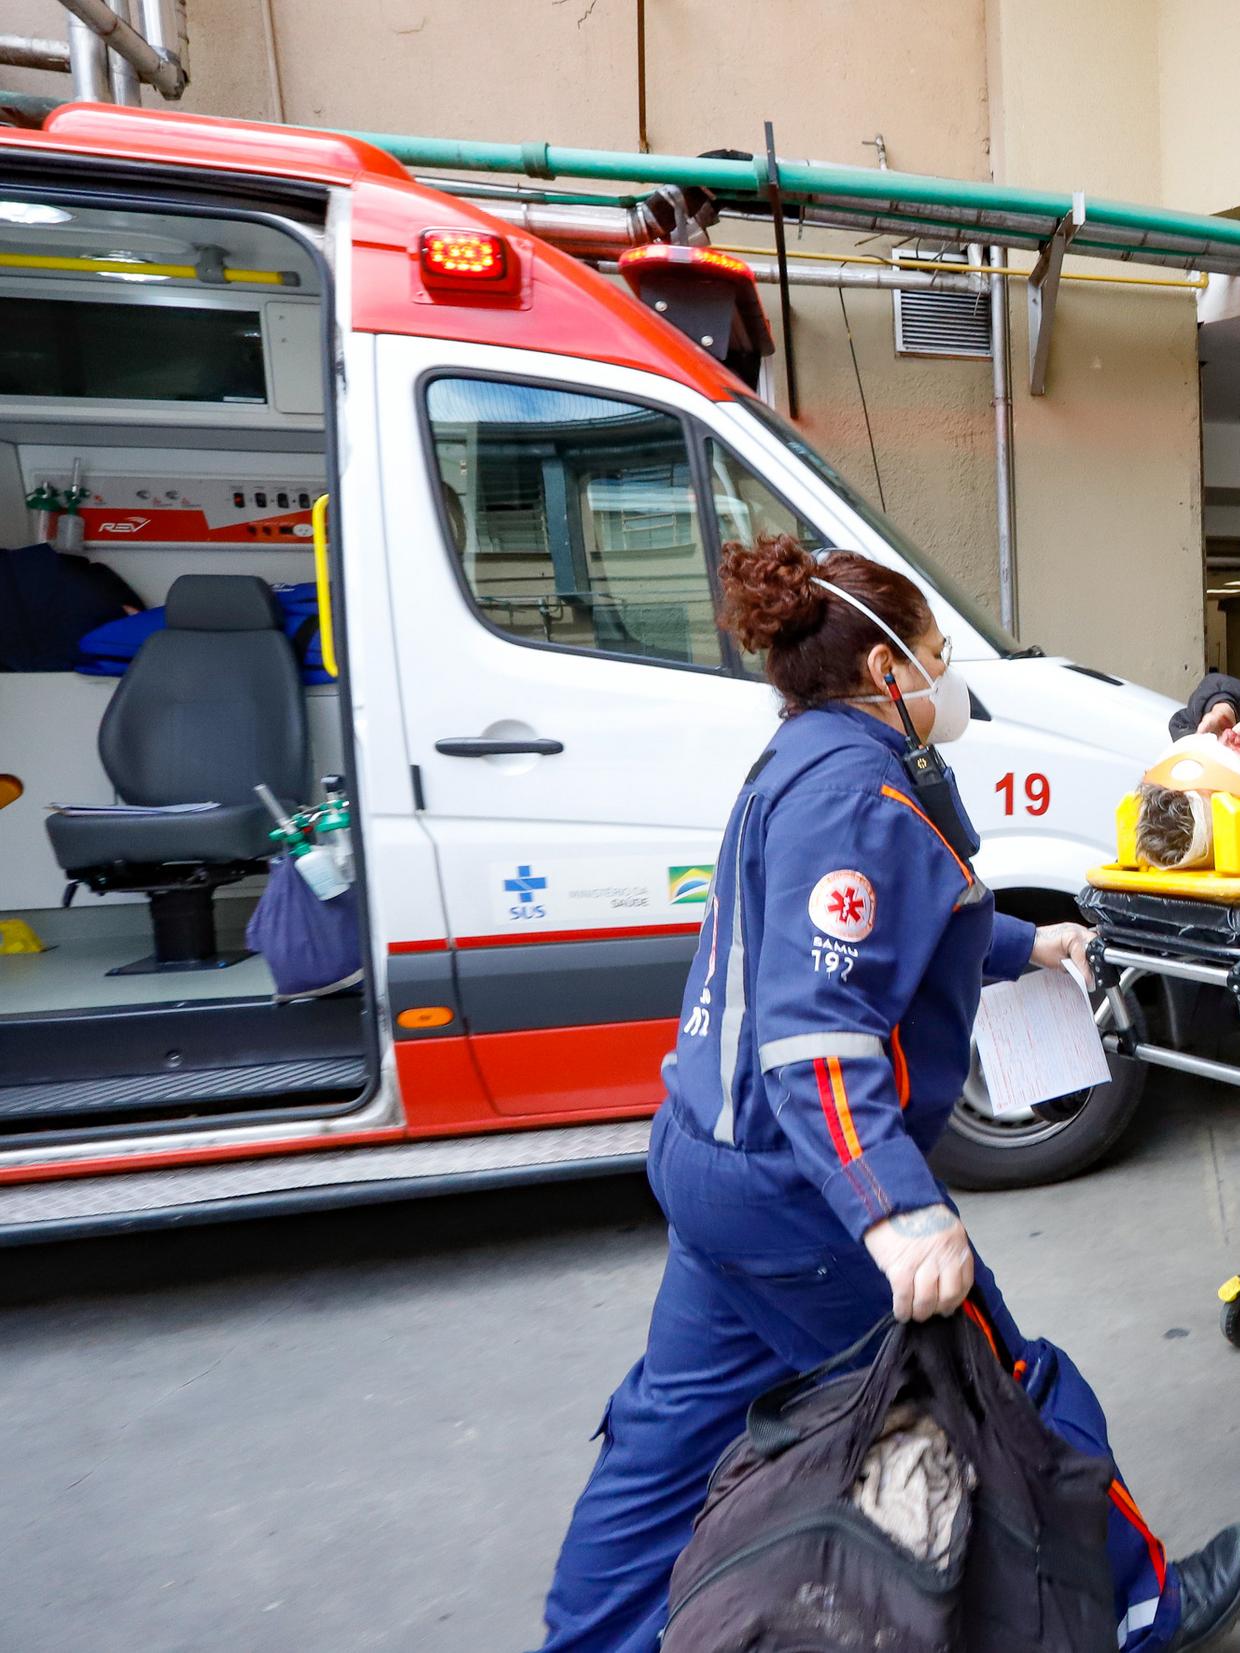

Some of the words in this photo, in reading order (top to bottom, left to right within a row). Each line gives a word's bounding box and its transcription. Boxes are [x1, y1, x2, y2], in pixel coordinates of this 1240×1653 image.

[995, 772, 1051, 817] 19
[509, 904, 547, 920] SUS
[811, 949, 854, 982] 192
